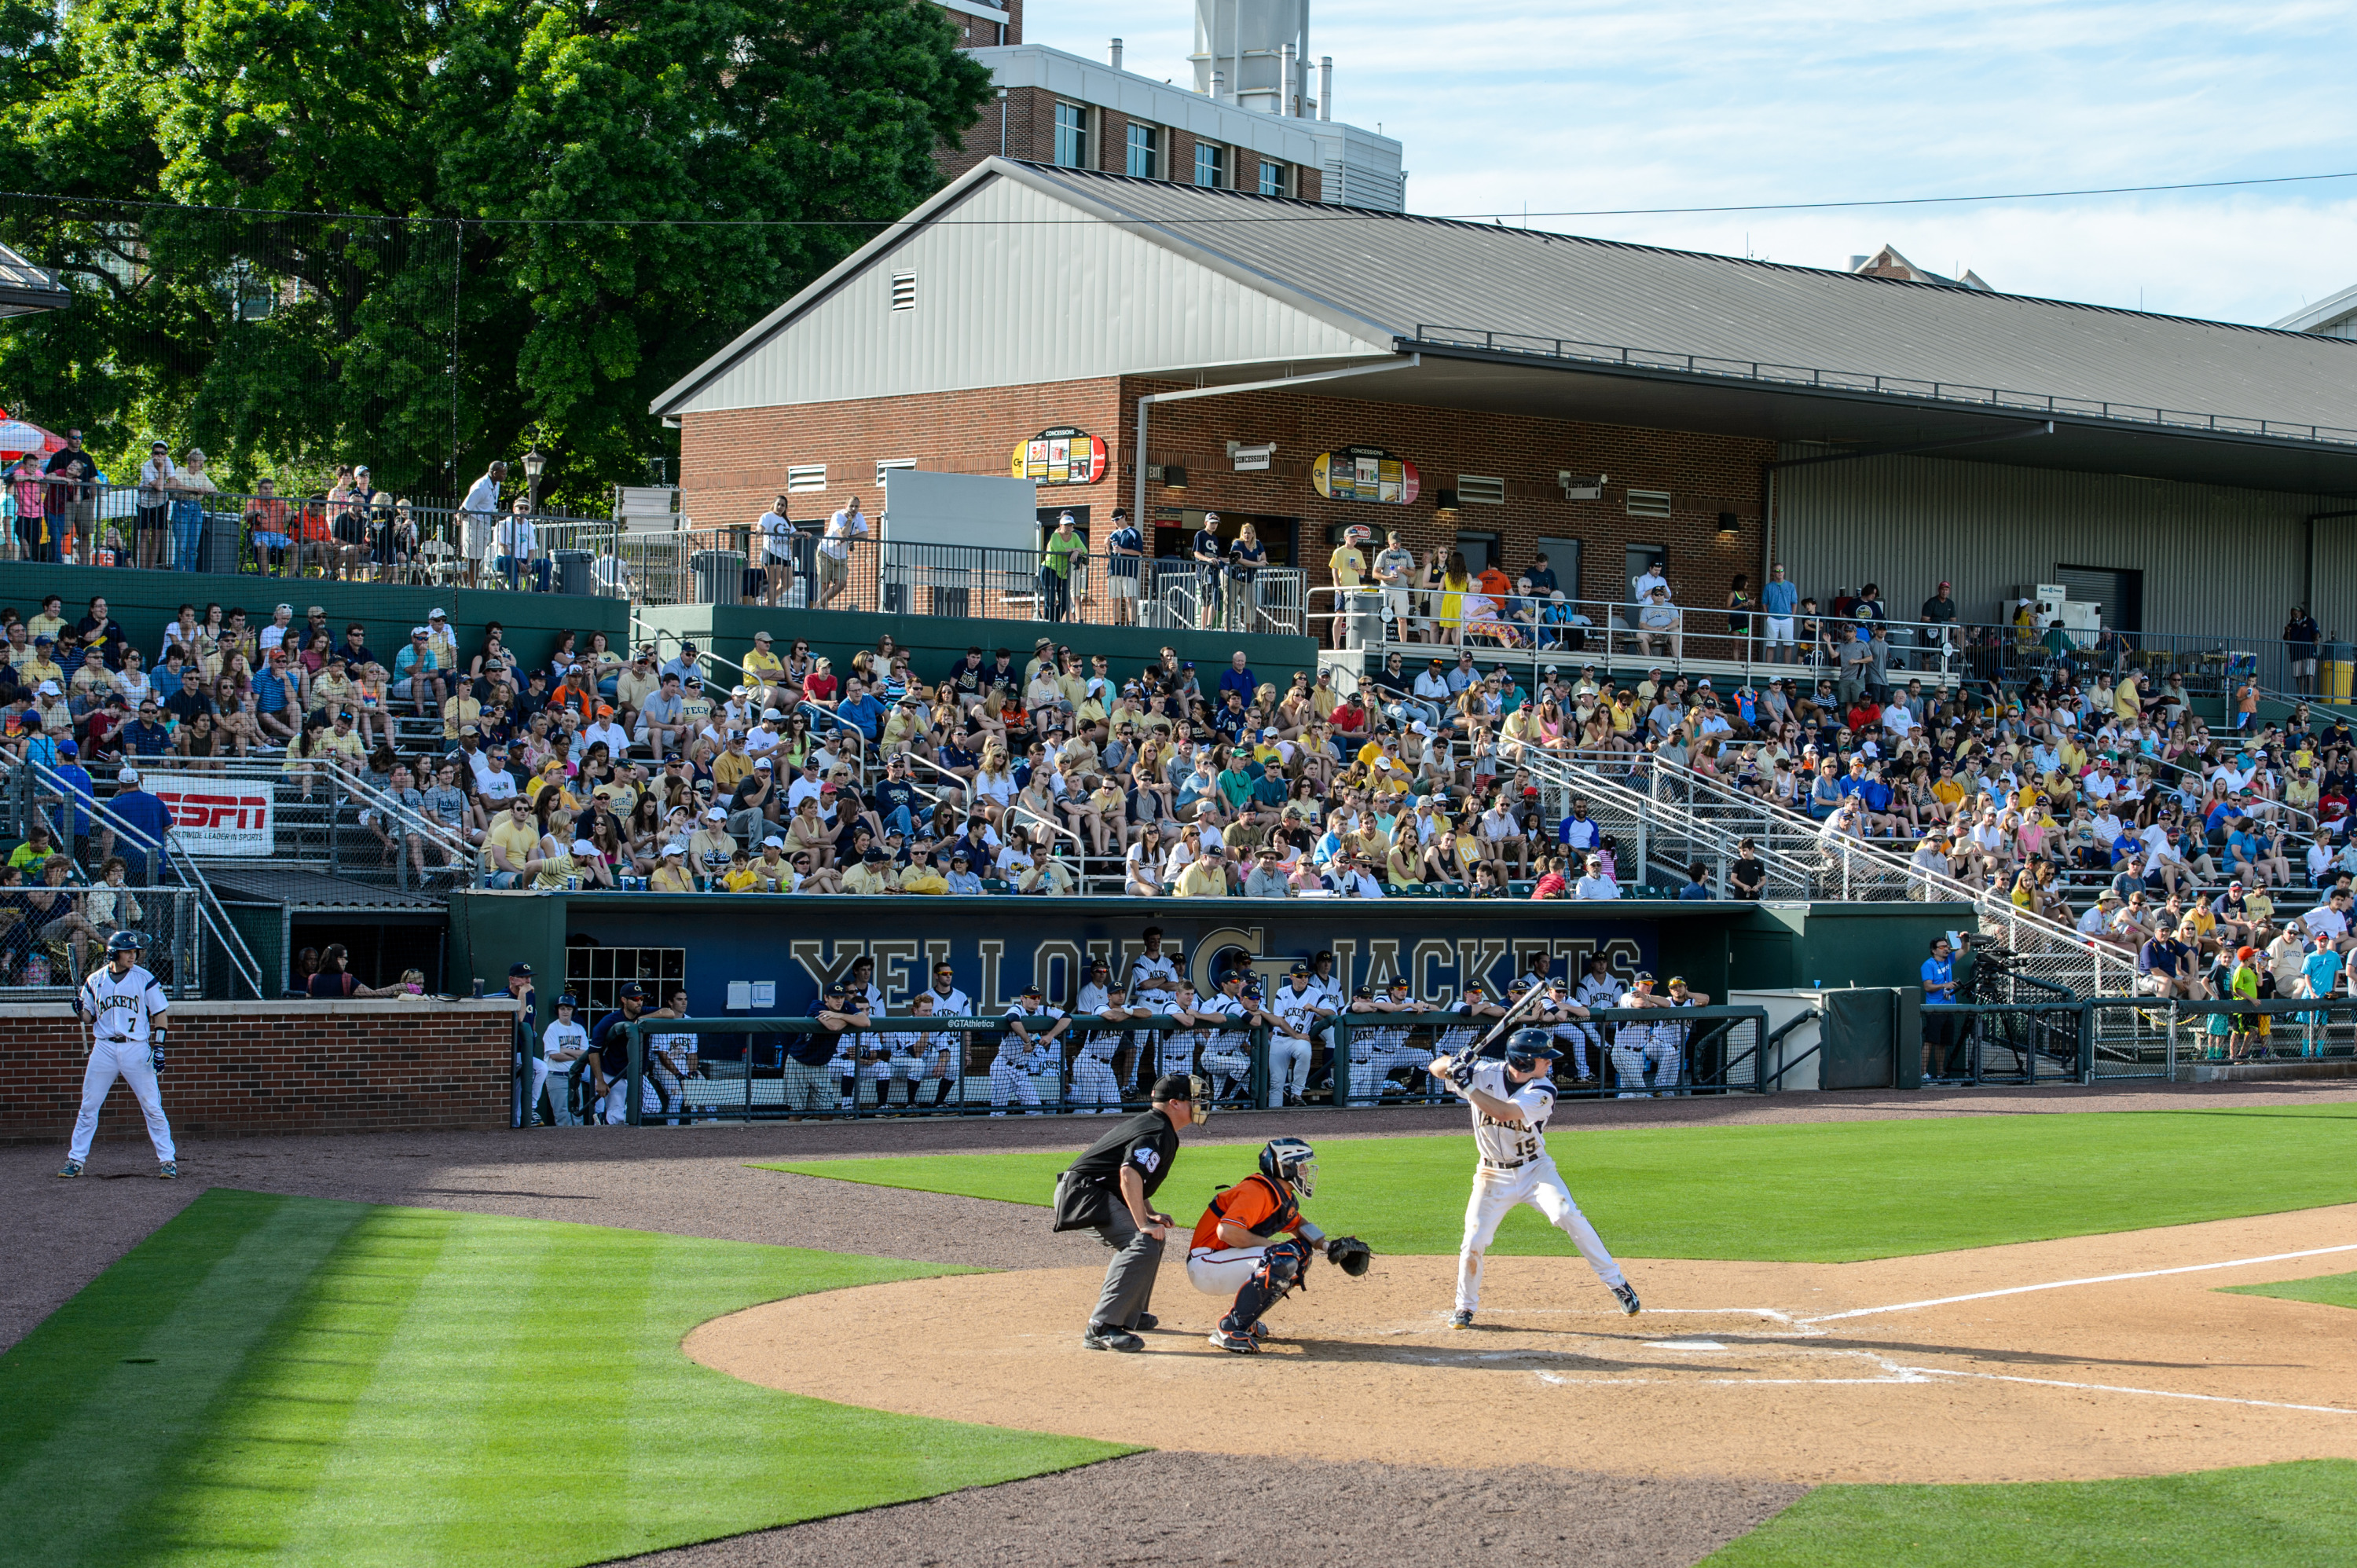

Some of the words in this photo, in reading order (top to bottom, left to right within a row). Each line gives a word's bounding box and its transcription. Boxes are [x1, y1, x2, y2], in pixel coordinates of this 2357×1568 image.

[1235, 454, 1269, 463] CONCESSIONS
[1149, 467, 1160, 478] EXIT
[1567, 480, 1600, 489] RESTROOMS
[683, 706, 709, 716] TECH
[1227, 721, 1237, 731] 19
[610, 798, 632, 808] GEORGIA
[156, 792, 266, 829] ESPN
[790, 939, 1183, 1018] YELLOW
[1332, 939, 1642, 1013] JACKETS
[1285, 1007, 1307, 1021] ACKETS
[128, 1018, 137, 1033] 7
[948, 1019, 995, 1028] @GTAthletics
[1516, 1137, 1537, 1156] 15
[1134, 1147, 1160, 1173] 49
